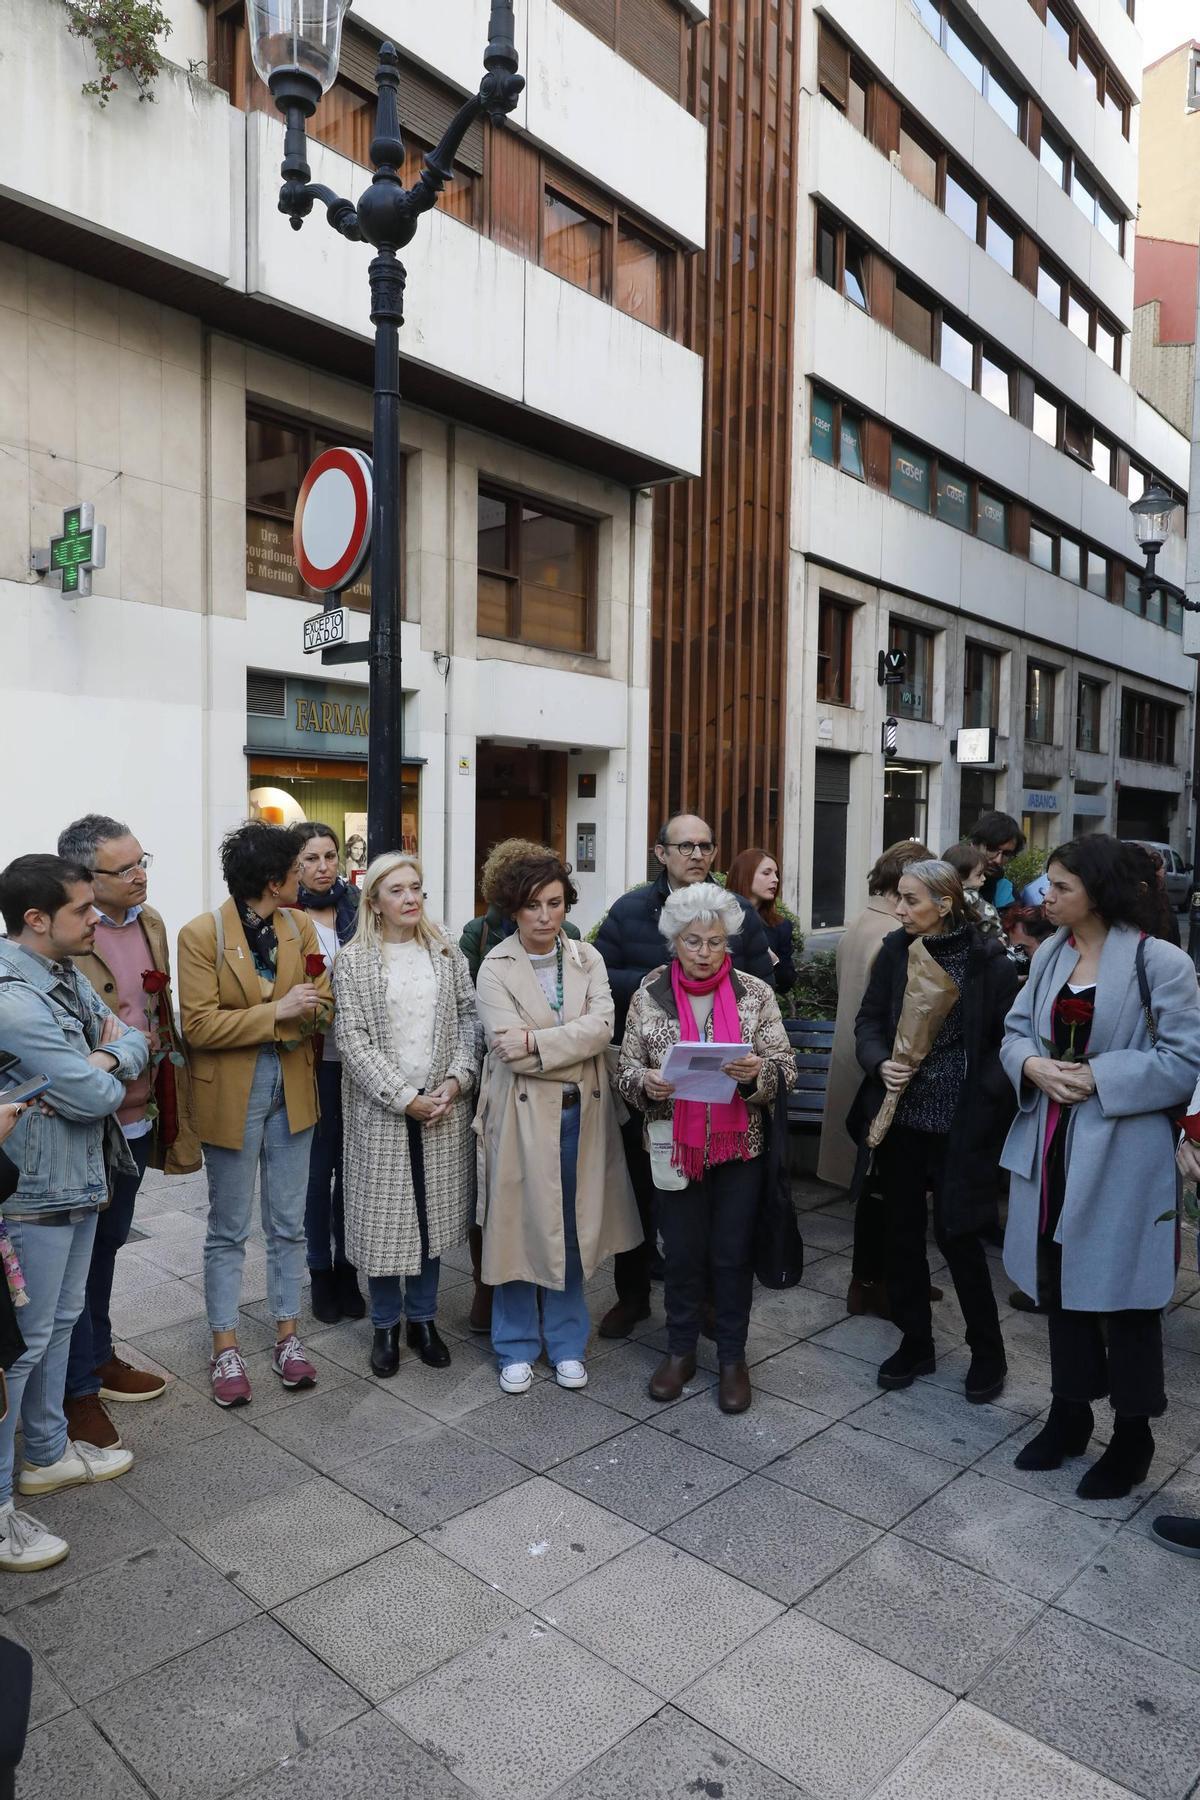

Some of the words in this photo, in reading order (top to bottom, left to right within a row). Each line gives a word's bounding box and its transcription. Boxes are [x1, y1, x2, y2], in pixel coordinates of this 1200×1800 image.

[815, 416, 831, 433] caser
[901, 463, 924, 482] caser
[946, 485, 967, 505] caser
[261, 528, 281, 545] Dra.
[247, 561, 257, 576] G.
[259, 564, 294, 584] Merino
[305, 614, 342, 636] EXCEPTO
[309, 626, 338, 646] VADO
